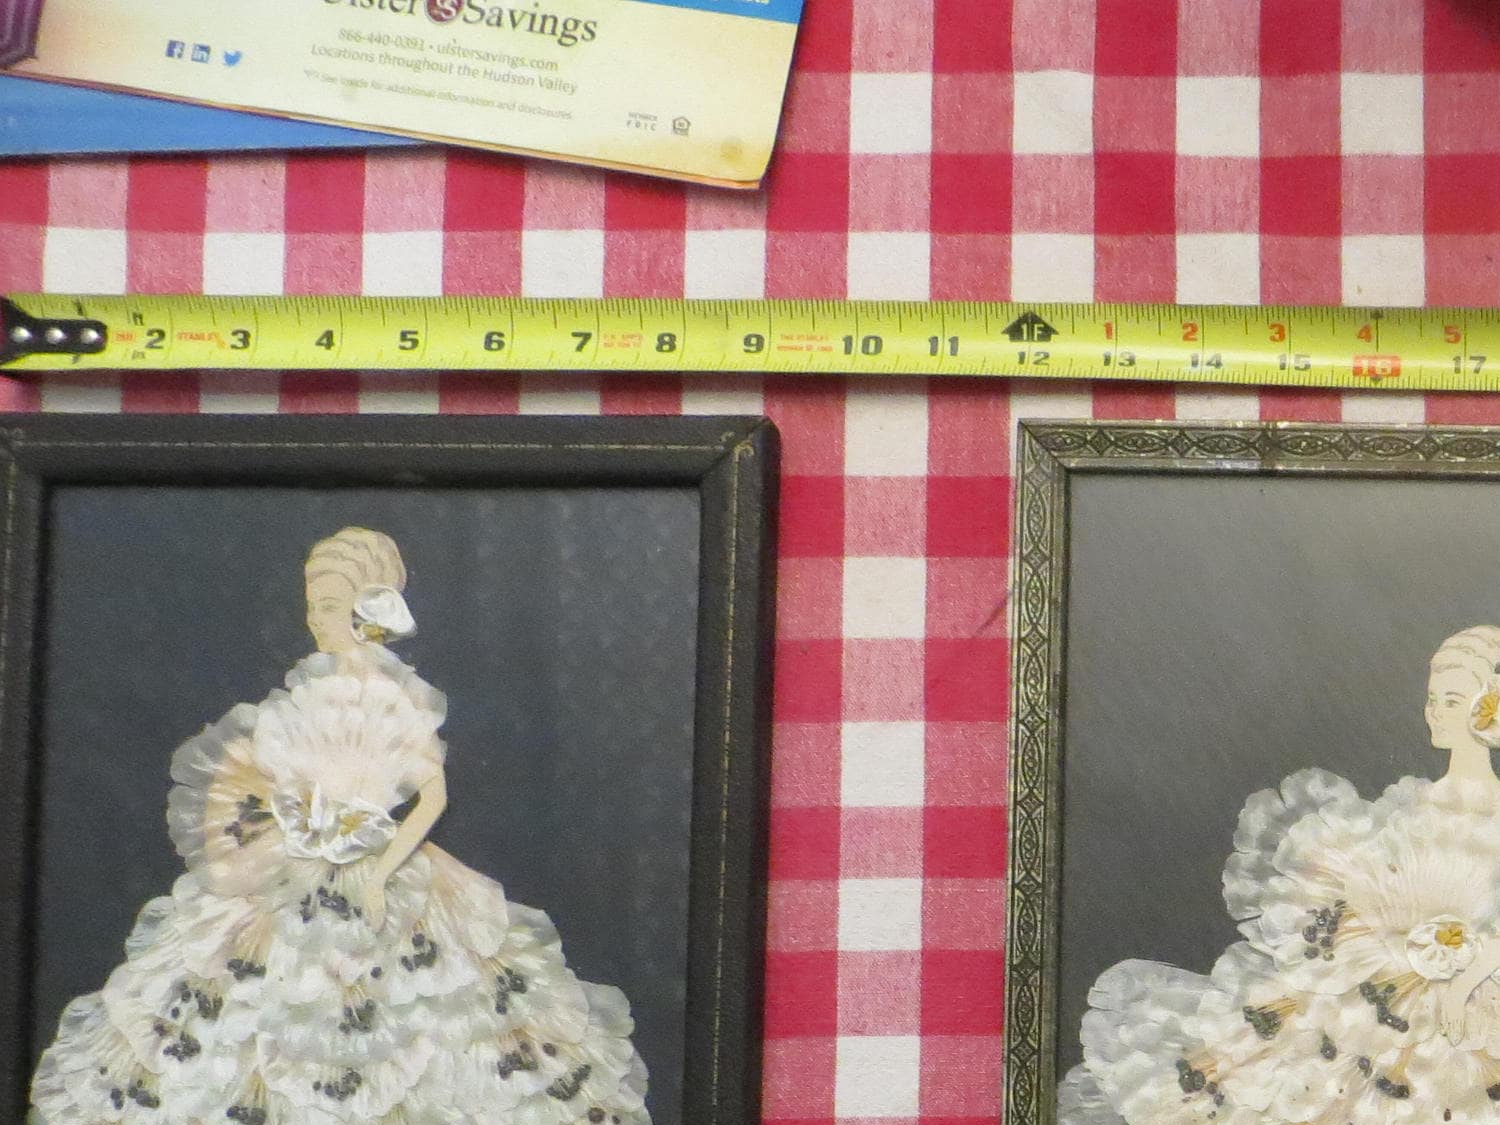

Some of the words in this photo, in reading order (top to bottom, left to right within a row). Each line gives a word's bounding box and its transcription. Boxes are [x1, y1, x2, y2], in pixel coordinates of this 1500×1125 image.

[462, 0, 598, 47] Savings
[311, 44, 375, 62] Locations
[378, 51, 453, 76] throughout
[457, 63, 479, 78] the
[483, 68, 535, 87] Hudson
[538, 76, 579, 96] Valley
[436, 43, 559, 72] ulstersavings.com
[1020, 323, 1044, 341] 1F
[1104, 322, 1113, 339] 1
[1182, 323, 1198, 341] 2
[1269, 324, 1285, 342] 3
[1357, 325, 1372, 343] 4
[1443, 326, 1461, 344] 5
[145, 328, 165, 349] 2
[231, 329, 250, 350] 3
[315, 329, 334, 350] 4
[399, 330, 419, 351] 5
[483, 331, 505, 351] 6
[571, 331, 592, 352] 7
[655, 332, 677, 353] 8
[743, 333, 764, 353] 9
[842, 334, 883, 355] 10
[928, 336, 959, 356] 11
[1018, 351, 1050, 366] 12
[1103, 352, 1135, 367] 13
[1190, 352, 1223, 369] 14
[1278, 354, 1311, 371] 15
[1452, 356, 1486, 374] 17
